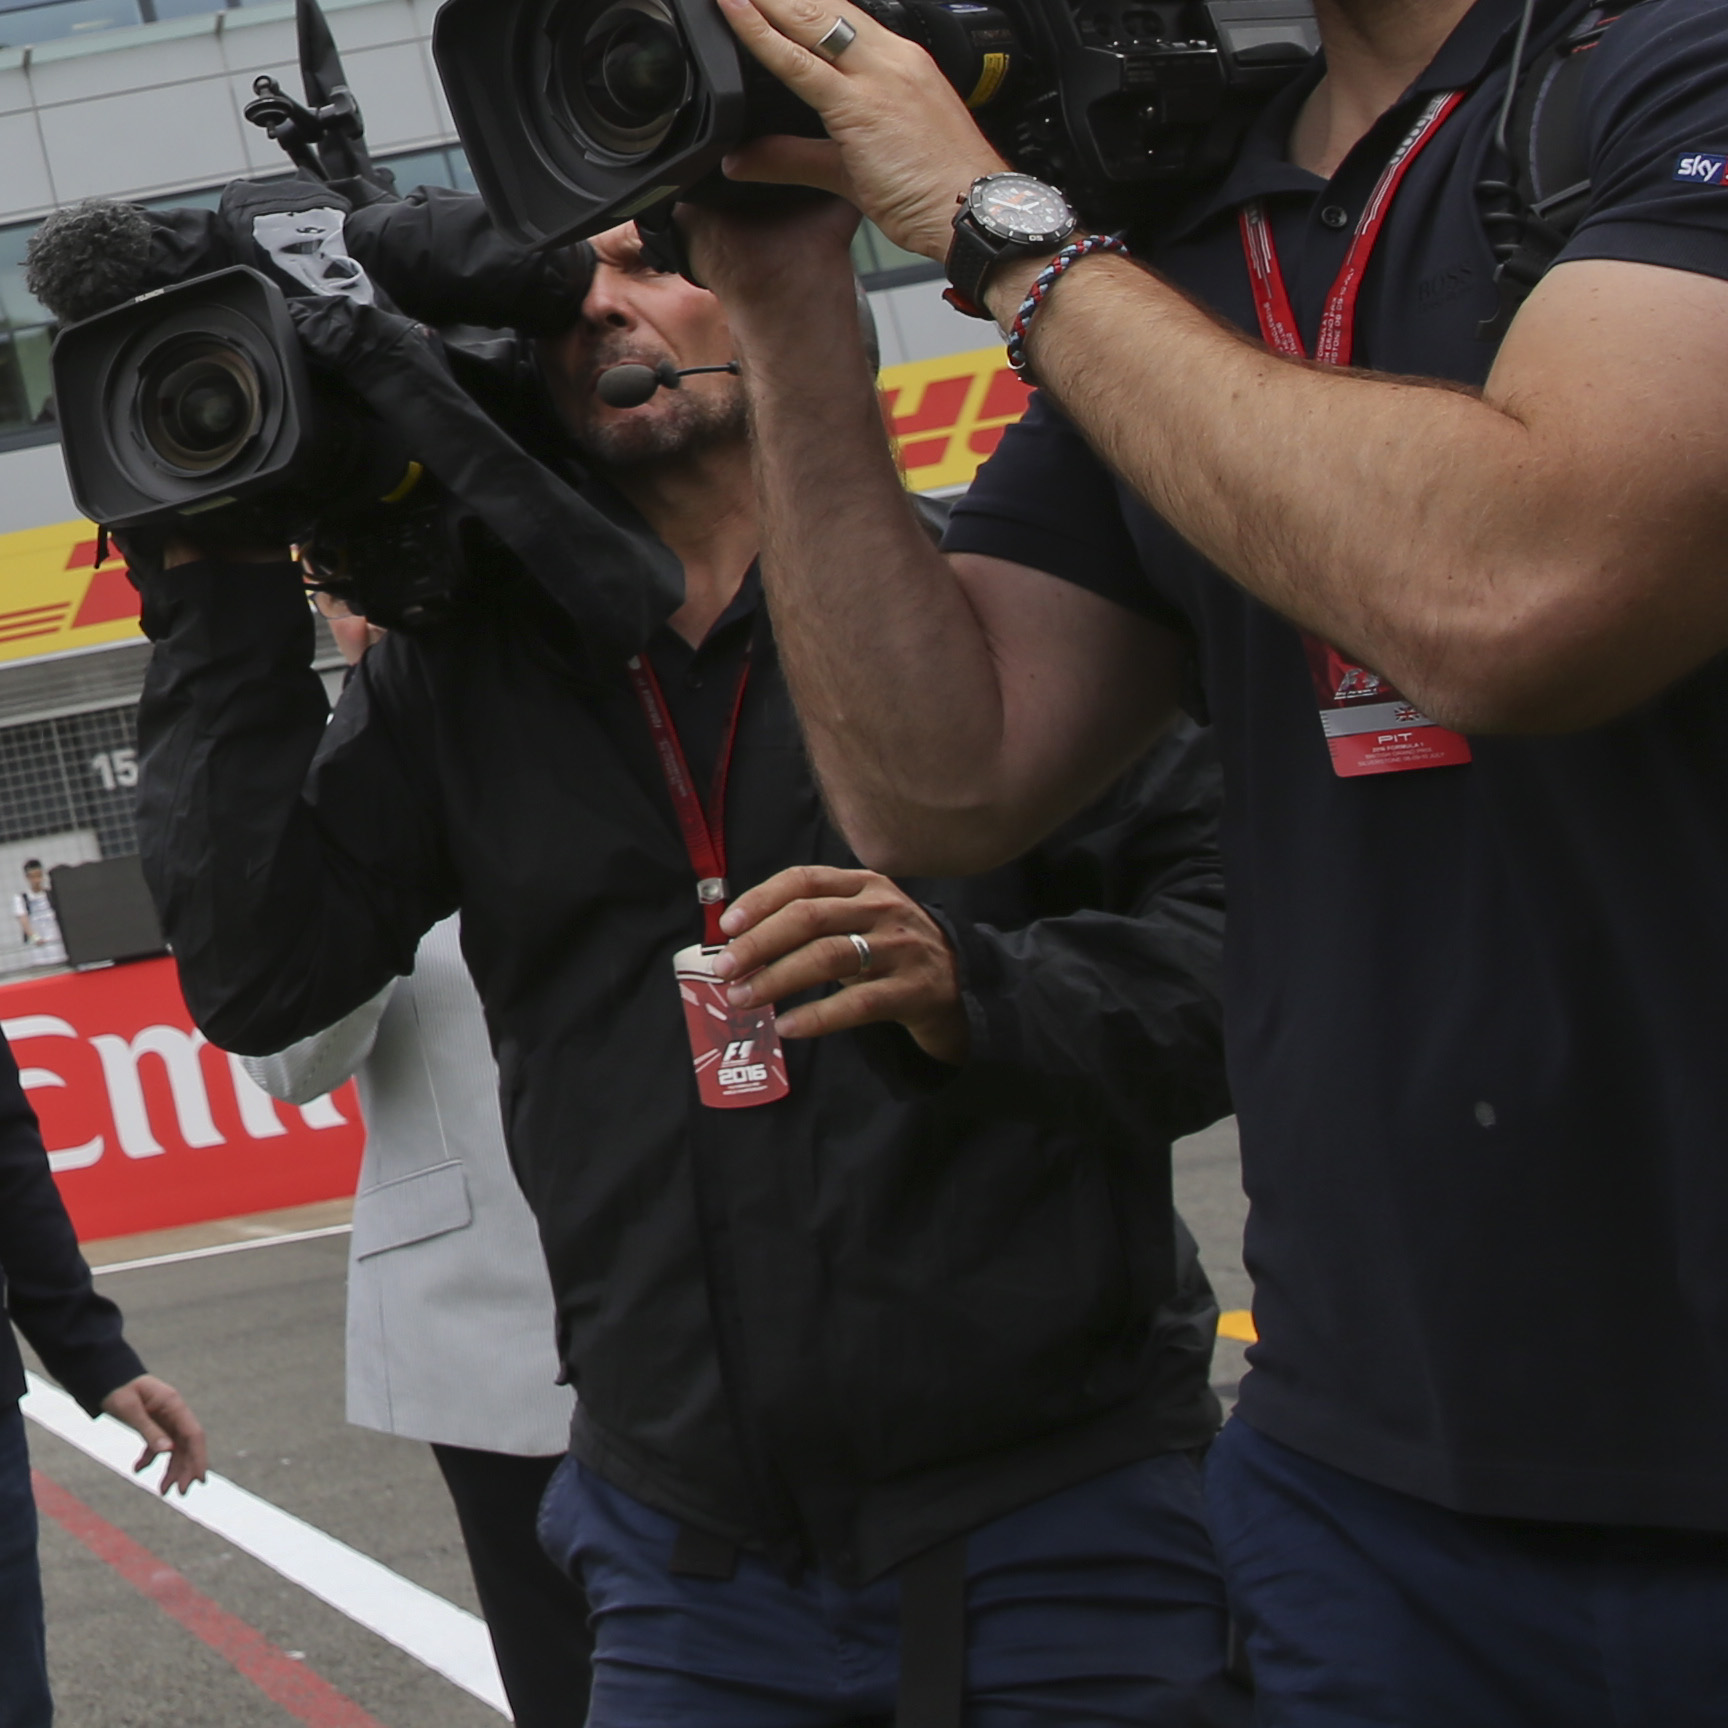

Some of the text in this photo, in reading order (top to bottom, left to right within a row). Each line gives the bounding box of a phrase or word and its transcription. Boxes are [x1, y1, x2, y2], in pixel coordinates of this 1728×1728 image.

[1677, 155, 1722, 182] sky
[1377, 732, 1412, 744] PIT
[90, 748, 139, 791] 15
[718, 1064, 768, 1085] 2016
